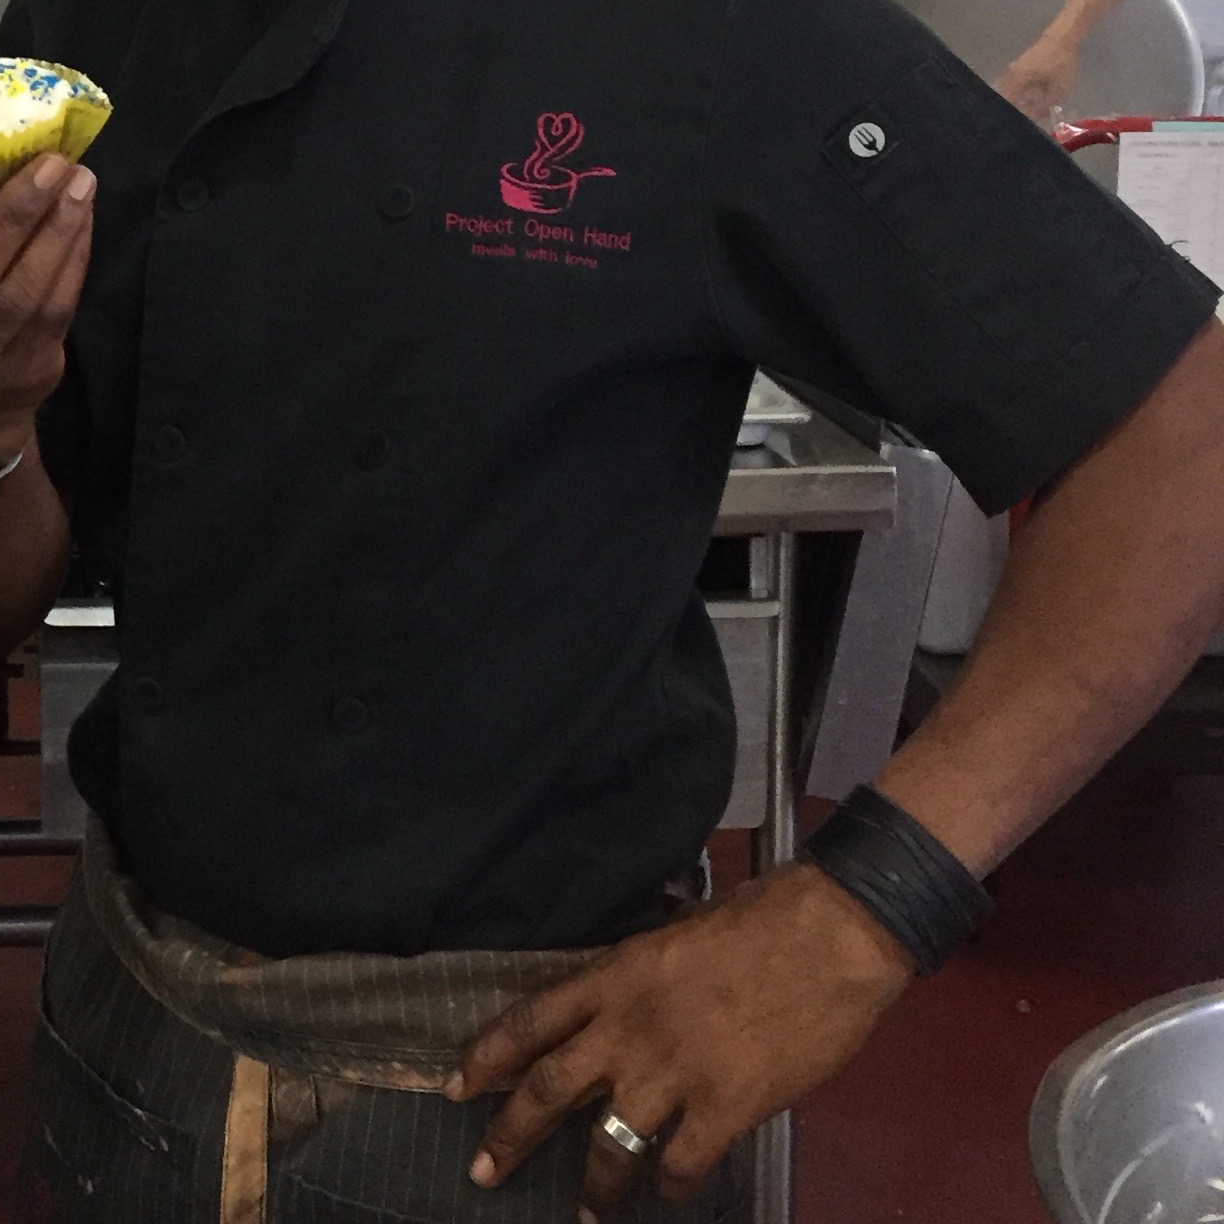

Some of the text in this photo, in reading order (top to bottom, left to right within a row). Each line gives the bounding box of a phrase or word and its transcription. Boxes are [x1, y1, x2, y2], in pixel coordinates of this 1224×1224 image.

[445, 212, 632, 252] Project Open Hand
